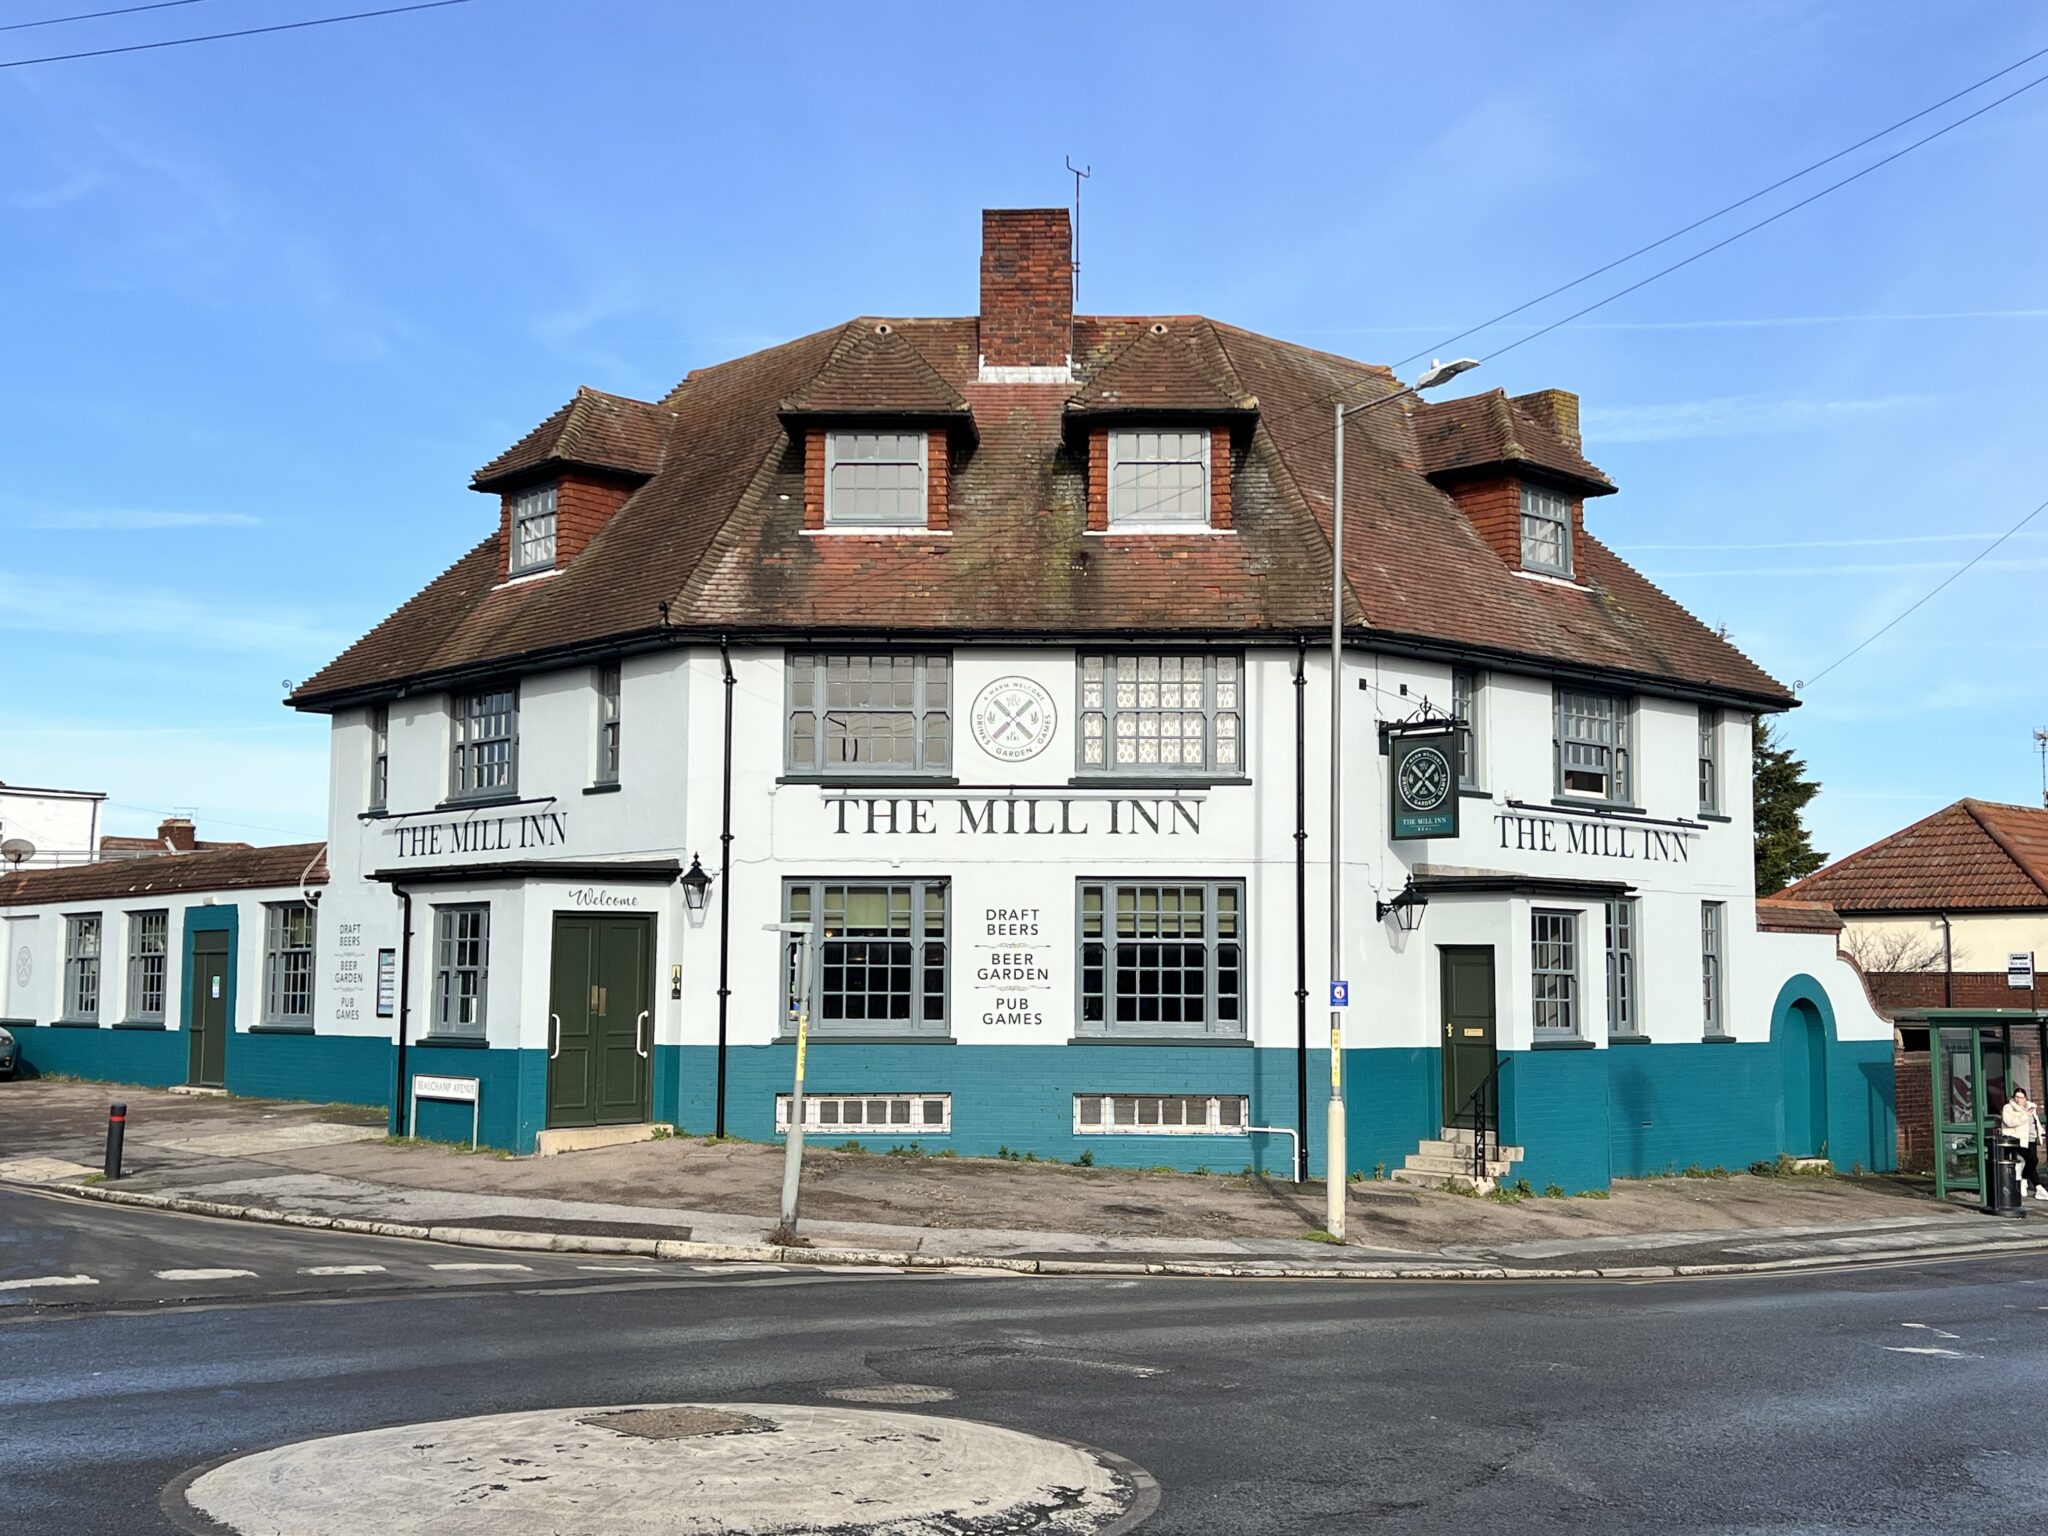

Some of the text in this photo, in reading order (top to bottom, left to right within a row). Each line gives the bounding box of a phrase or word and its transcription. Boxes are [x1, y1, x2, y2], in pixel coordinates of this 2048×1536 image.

[988, 683, 1009, 695] WARM
[1012, 682, 1045, 701] WELCOME
[976, 714, 1051, 758] DRINKS GARDEN GAMES
[1413, 799, 1436, 807] GARDEN
[824, 799, 1205, 834] THE MILL INN
[1417, 817, 1433, 825] MILL
[394, 812, 567, 858] THE MILL INN
[1493, 815, 1689, 863] THE MILL INN
[568, 887, 639, 906] Welcome
[986, 909, 1039, 921] DRAFT
[339, 924, 361, 934] DRAFT
[987, 924, 1039, 935] BEERS
[339, 936, 361, 946] BEERS
[991, 953, 1033, 965] BEER
[340, 960, 358, 971] BEER
[334, 973, 363, 983] GARDEN
[977, 968, 1048, 980] GARDEN
[341, 997, 354, 1007] PUB
[996, 998, 1029, 1010] PUB
[335, 1009, 360, 1020] GAMES
[982, 1013, 1042, 1025] GAMES
[417, 1080, 475, 1094] BEAUCHAMP AVENUE
